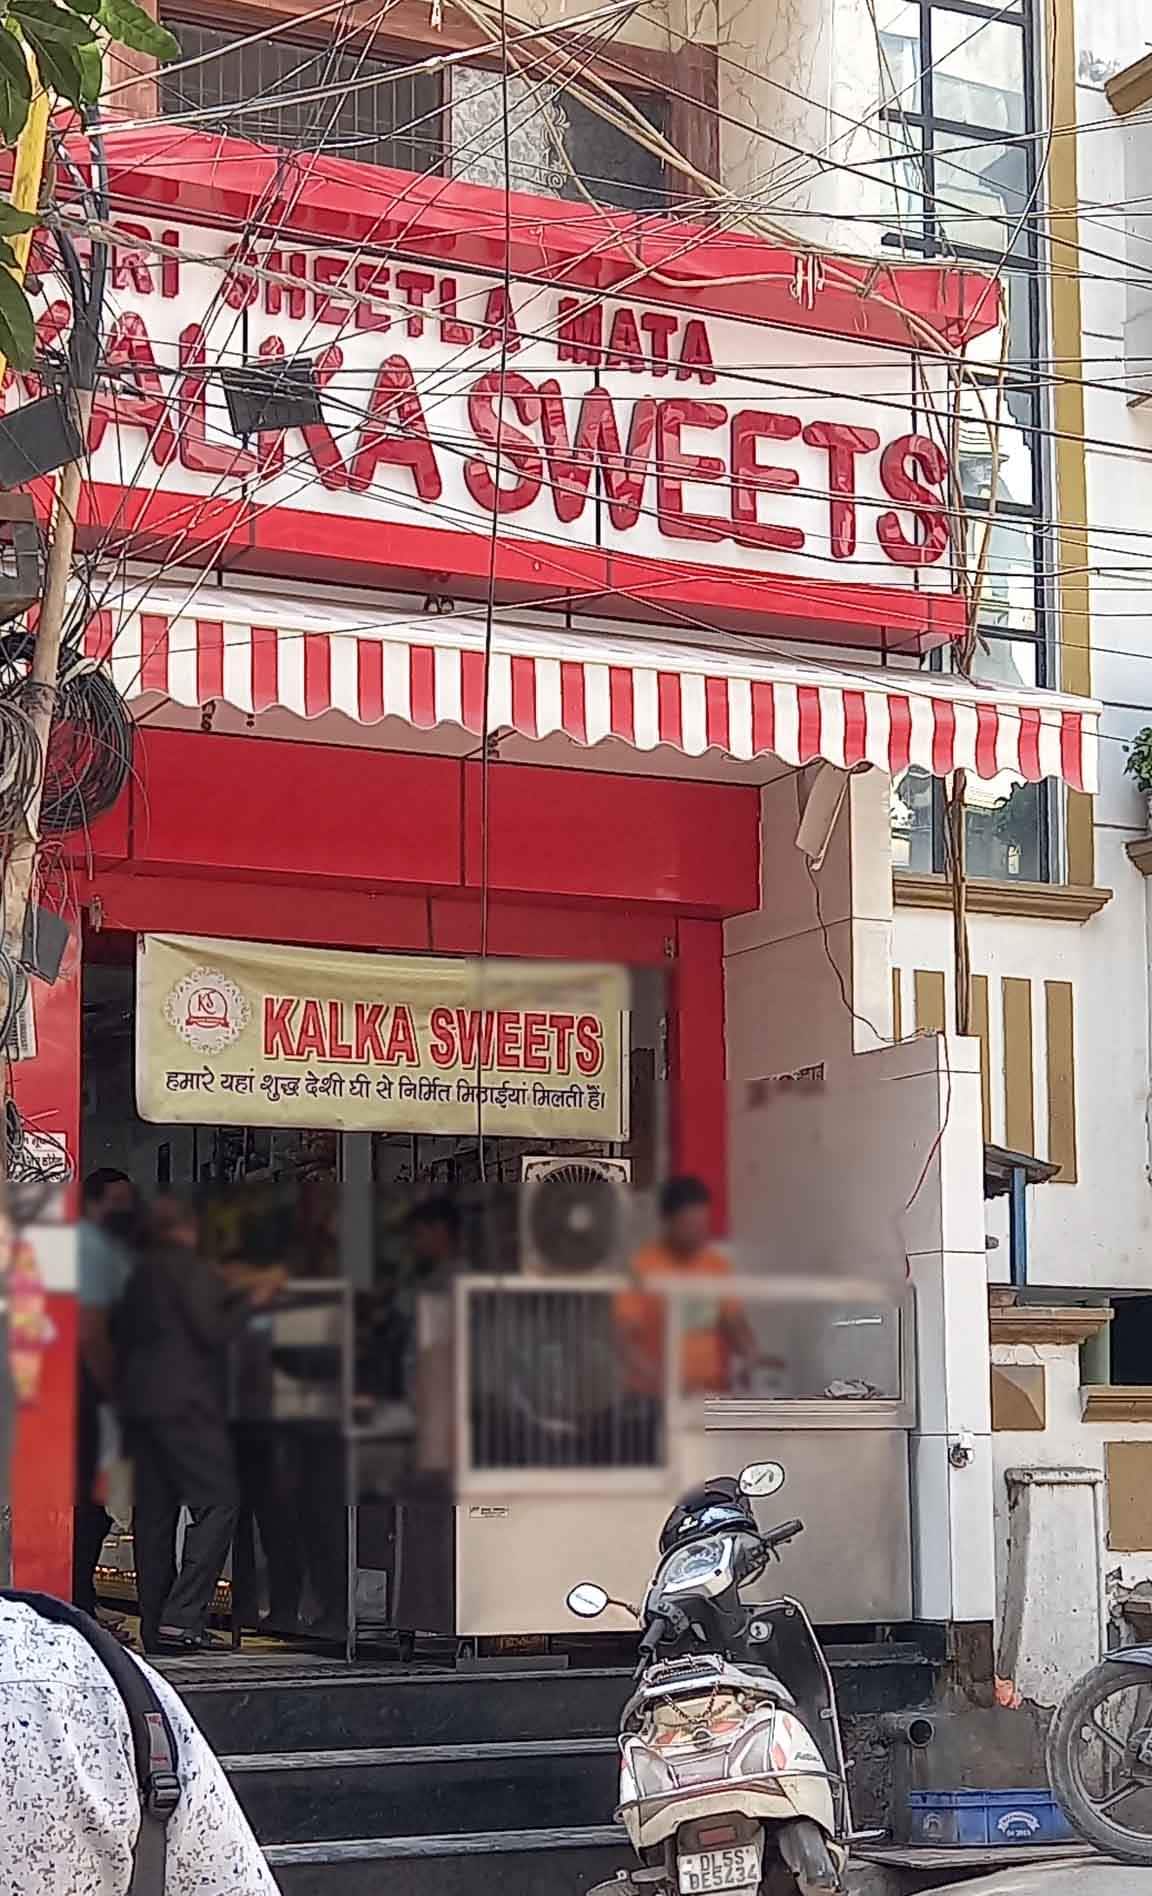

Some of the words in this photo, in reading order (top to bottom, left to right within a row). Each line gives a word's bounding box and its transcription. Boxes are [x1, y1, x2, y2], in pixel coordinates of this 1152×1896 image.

[221, 242, 521, 352] SHEETLA
[557, 297, 716, 385] MATA
[463, 370, 951, 566] SWEETS
[166, 1066, 214, 1092] हमारे
[220, 1068, 254, 1094] यहां
[306, 1070, 345, 1097] देशी
[349, 1073, 371, 1098] घी
[376, 1074, 394, 1099] से
[399, 1075, 451, 1101] निर्मित
[532, 1082, 584, 1108] मिलती
[263, 995, 419, 1068] KALKA
[428, 1005, 606, 1076] SWEETS
